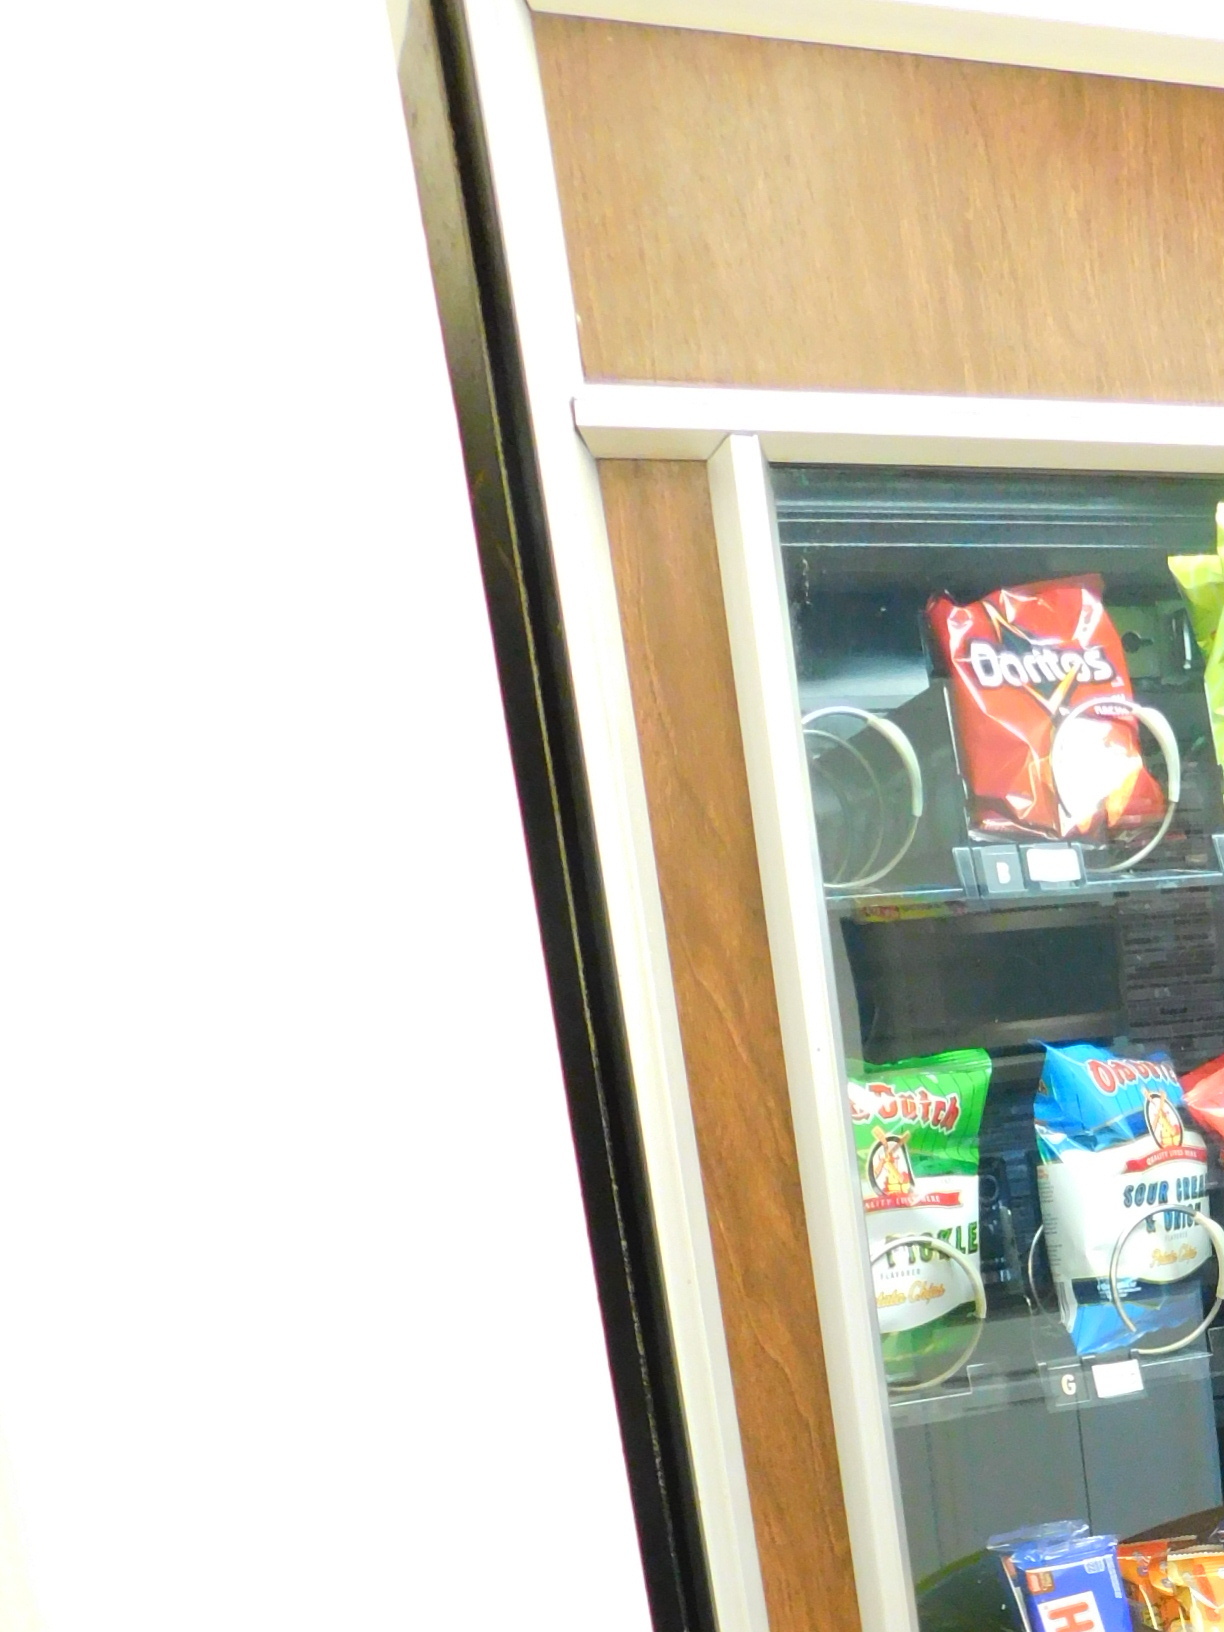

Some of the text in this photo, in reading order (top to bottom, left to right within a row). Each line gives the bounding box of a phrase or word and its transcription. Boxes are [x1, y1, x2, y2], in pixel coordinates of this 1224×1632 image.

[969, 641, 1115, 688] Doritos
[1123, 1180, 1169, 1209] SOUR
[885, 1221, 979, 1269] PICKLE
[880, 1268, 920, 1280] FLAVORED
[1060, 1373, 1077, 1396] G
